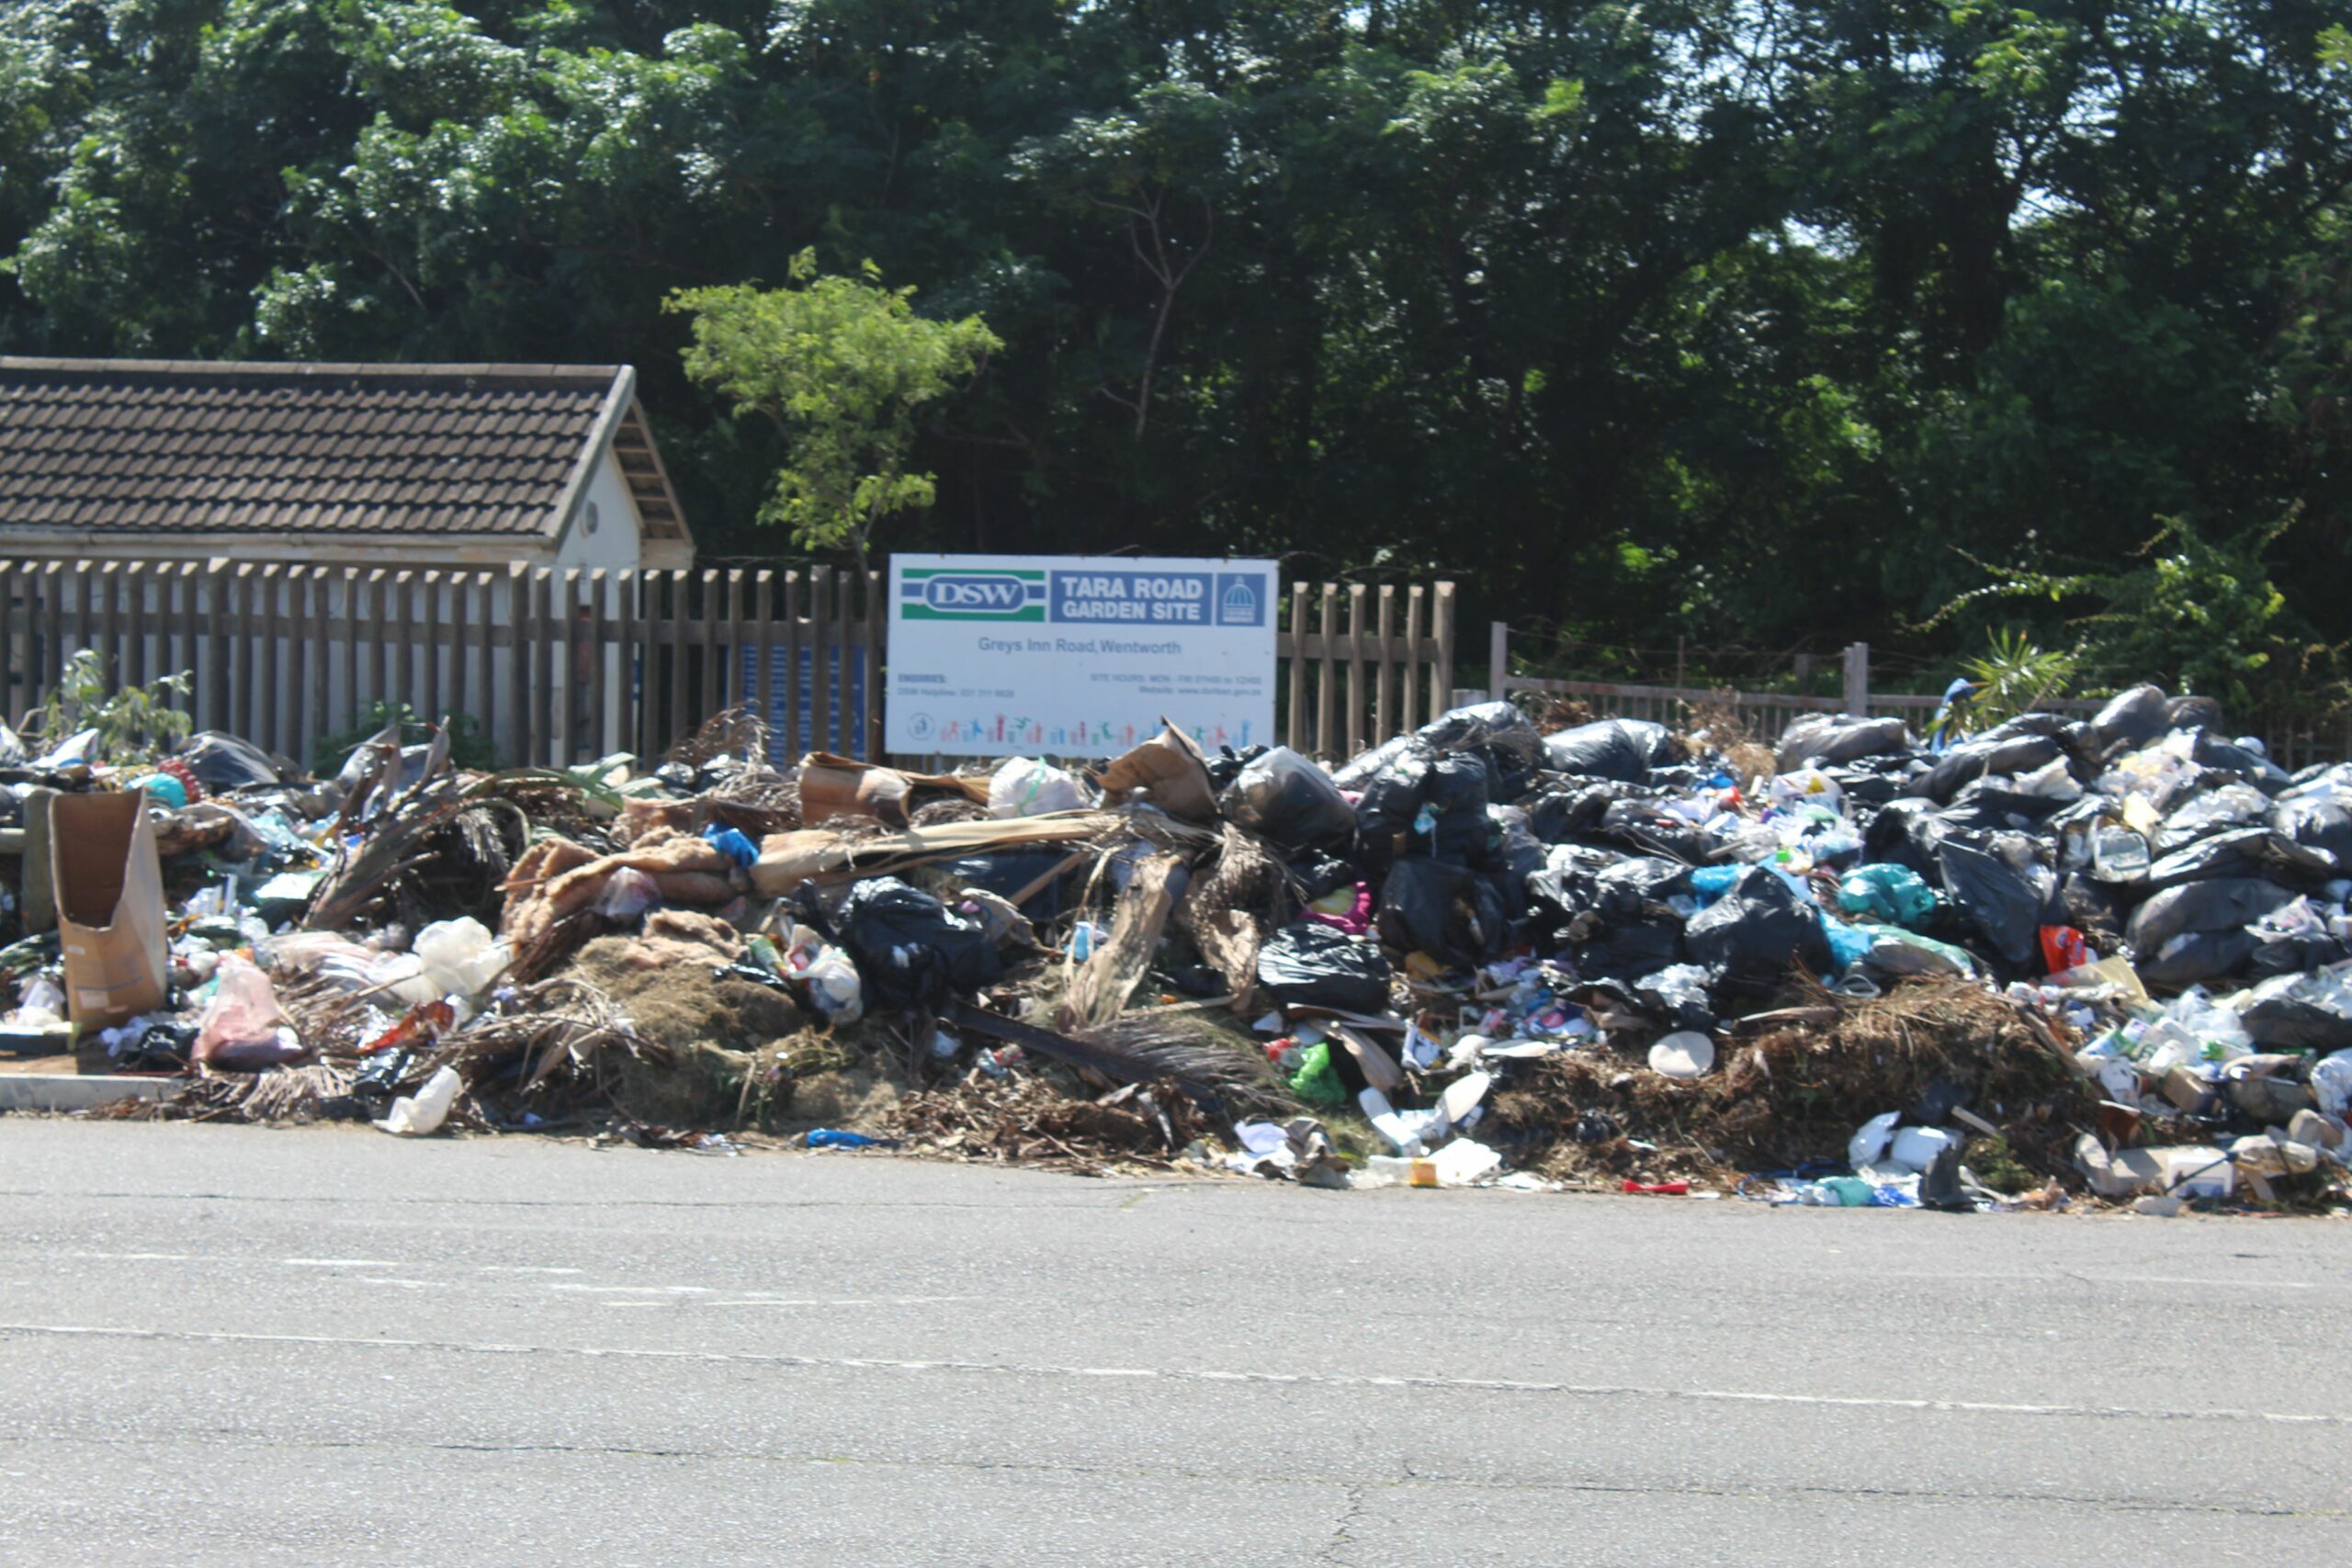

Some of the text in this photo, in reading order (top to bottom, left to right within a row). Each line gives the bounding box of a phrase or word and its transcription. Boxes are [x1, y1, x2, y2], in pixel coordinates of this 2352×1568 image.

[933, 582, 1020, 605] DSW
[1060, 576, 1204, 600] TARA ROAD
[1062, 601, 1147, 620] GARDEN
[1151, 603, 1201, 621] SITE
[978, 636, 1023, 655] Greys
[1027, 637, 1051, 652] Inn
[1100, 638, 1182, 655] Wentworth
